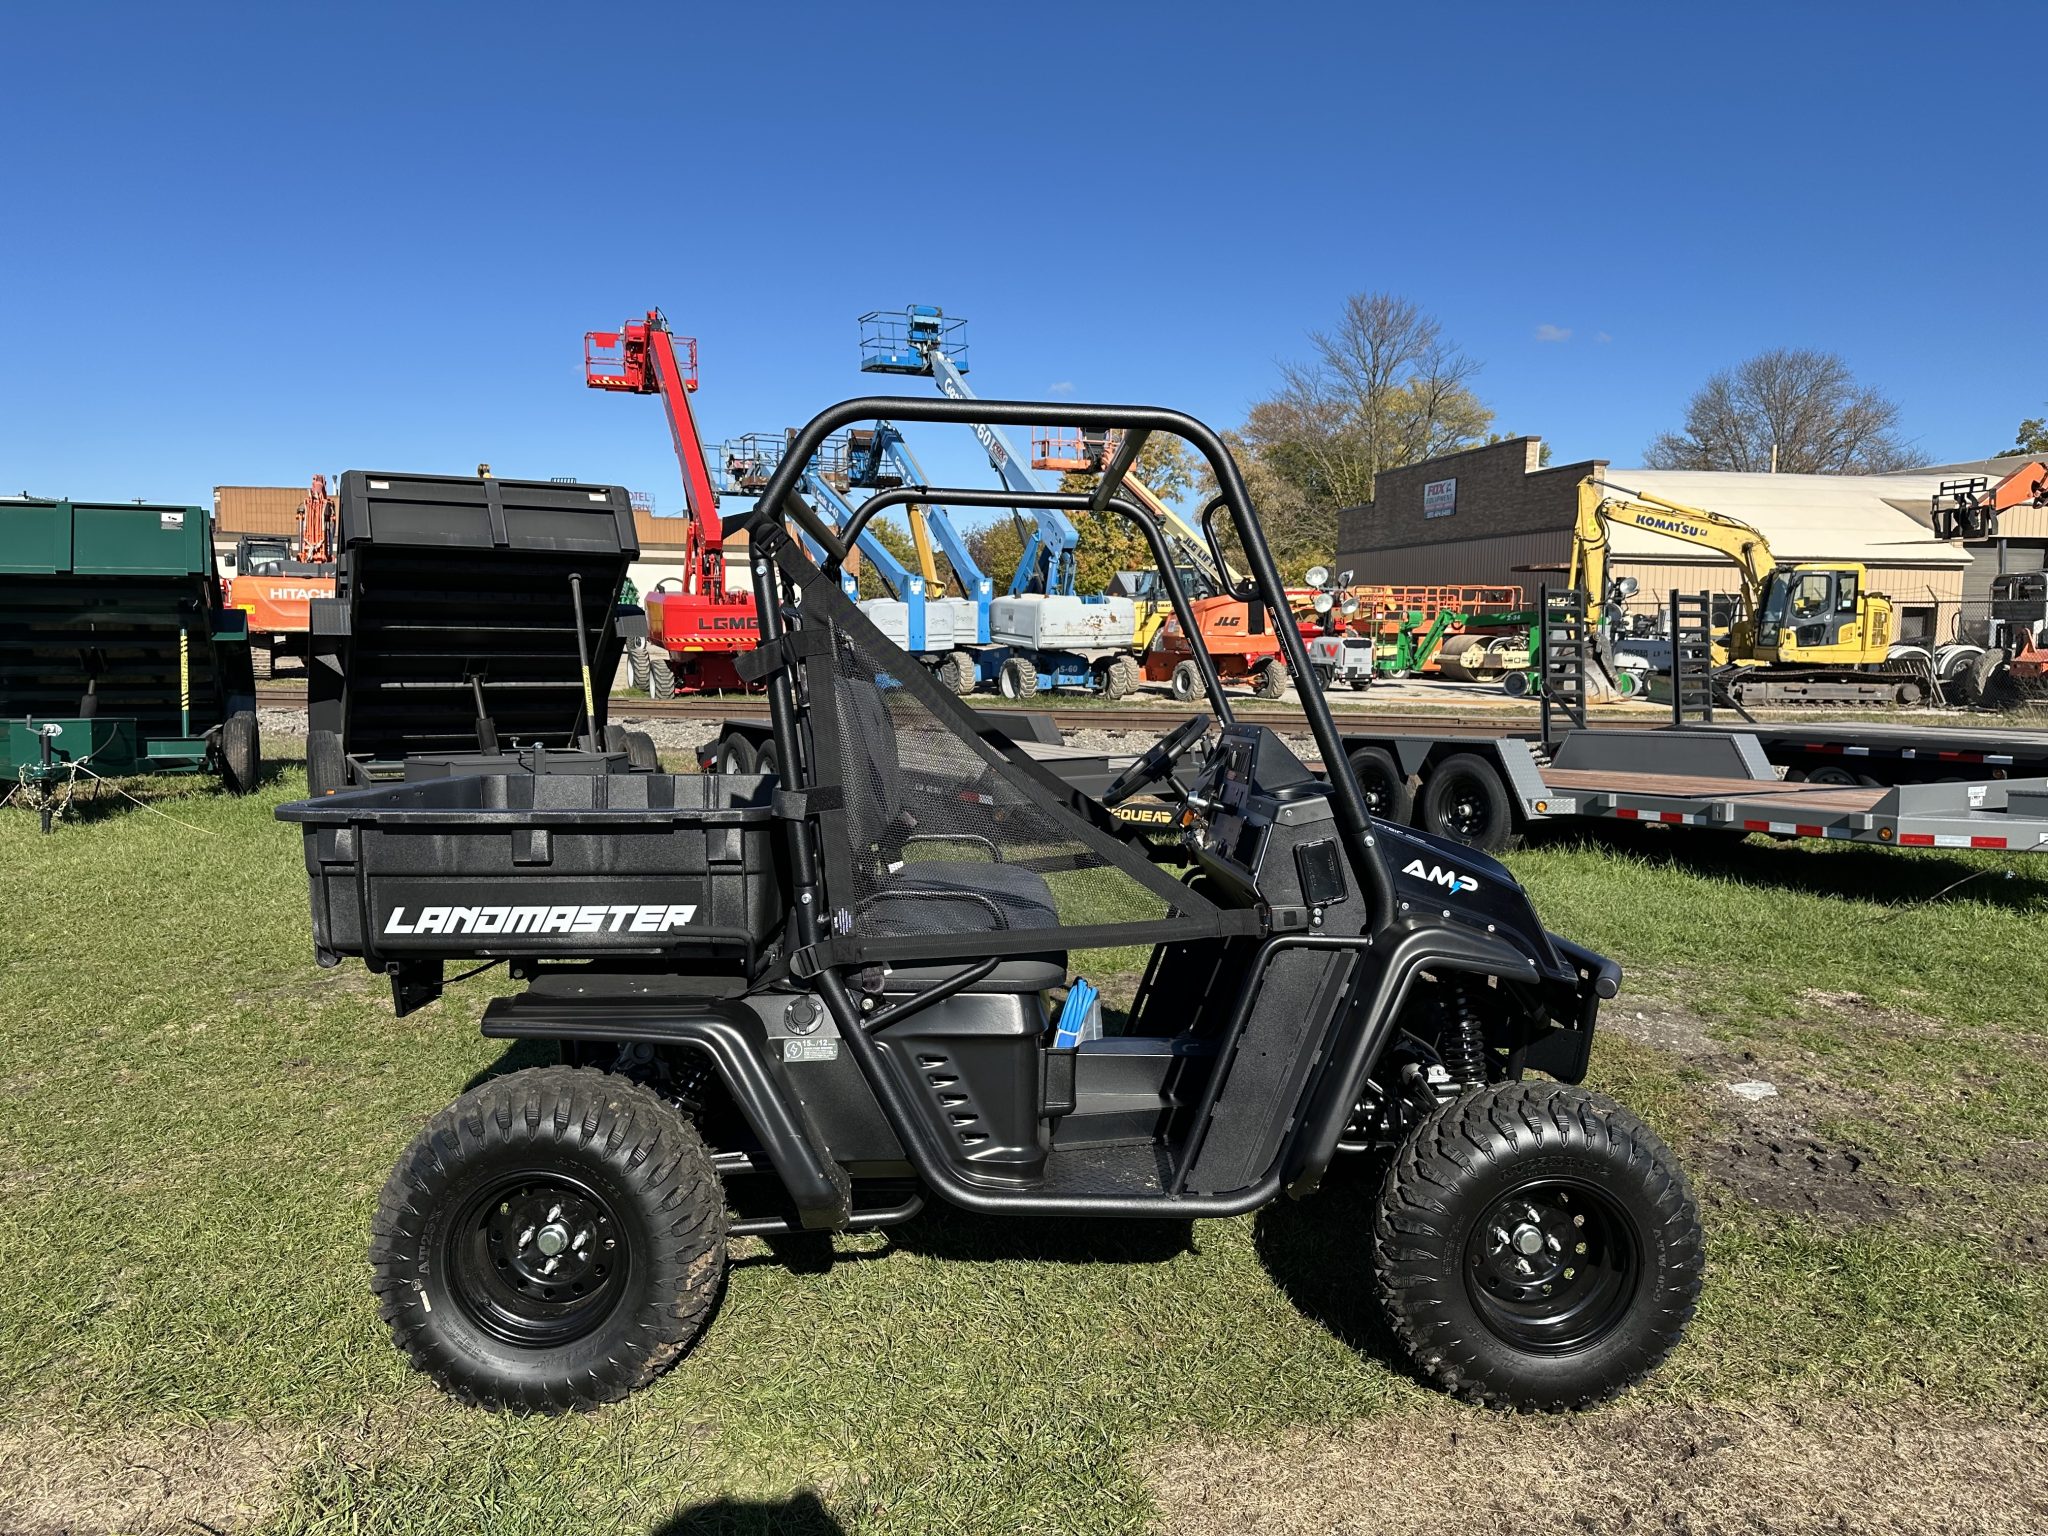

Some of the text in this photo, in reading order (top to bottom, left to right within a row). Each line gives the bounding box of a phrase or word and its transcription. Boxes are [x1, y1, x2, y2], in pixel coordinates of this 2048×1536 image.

[1428, 482, 1445, 497] FOX
[1636, 514, 1698, 536] KOMATSU
[1183, 538, 1198, 552] JLG
[698, 617, 760, 630] LGMG
[1214, 616, 1241, 627] JLG
[1059, 664, 1078, 674] S-60
[1402, 859, 1478, 895] AMP
[384, 905, 697, 933] LANDMASTER
